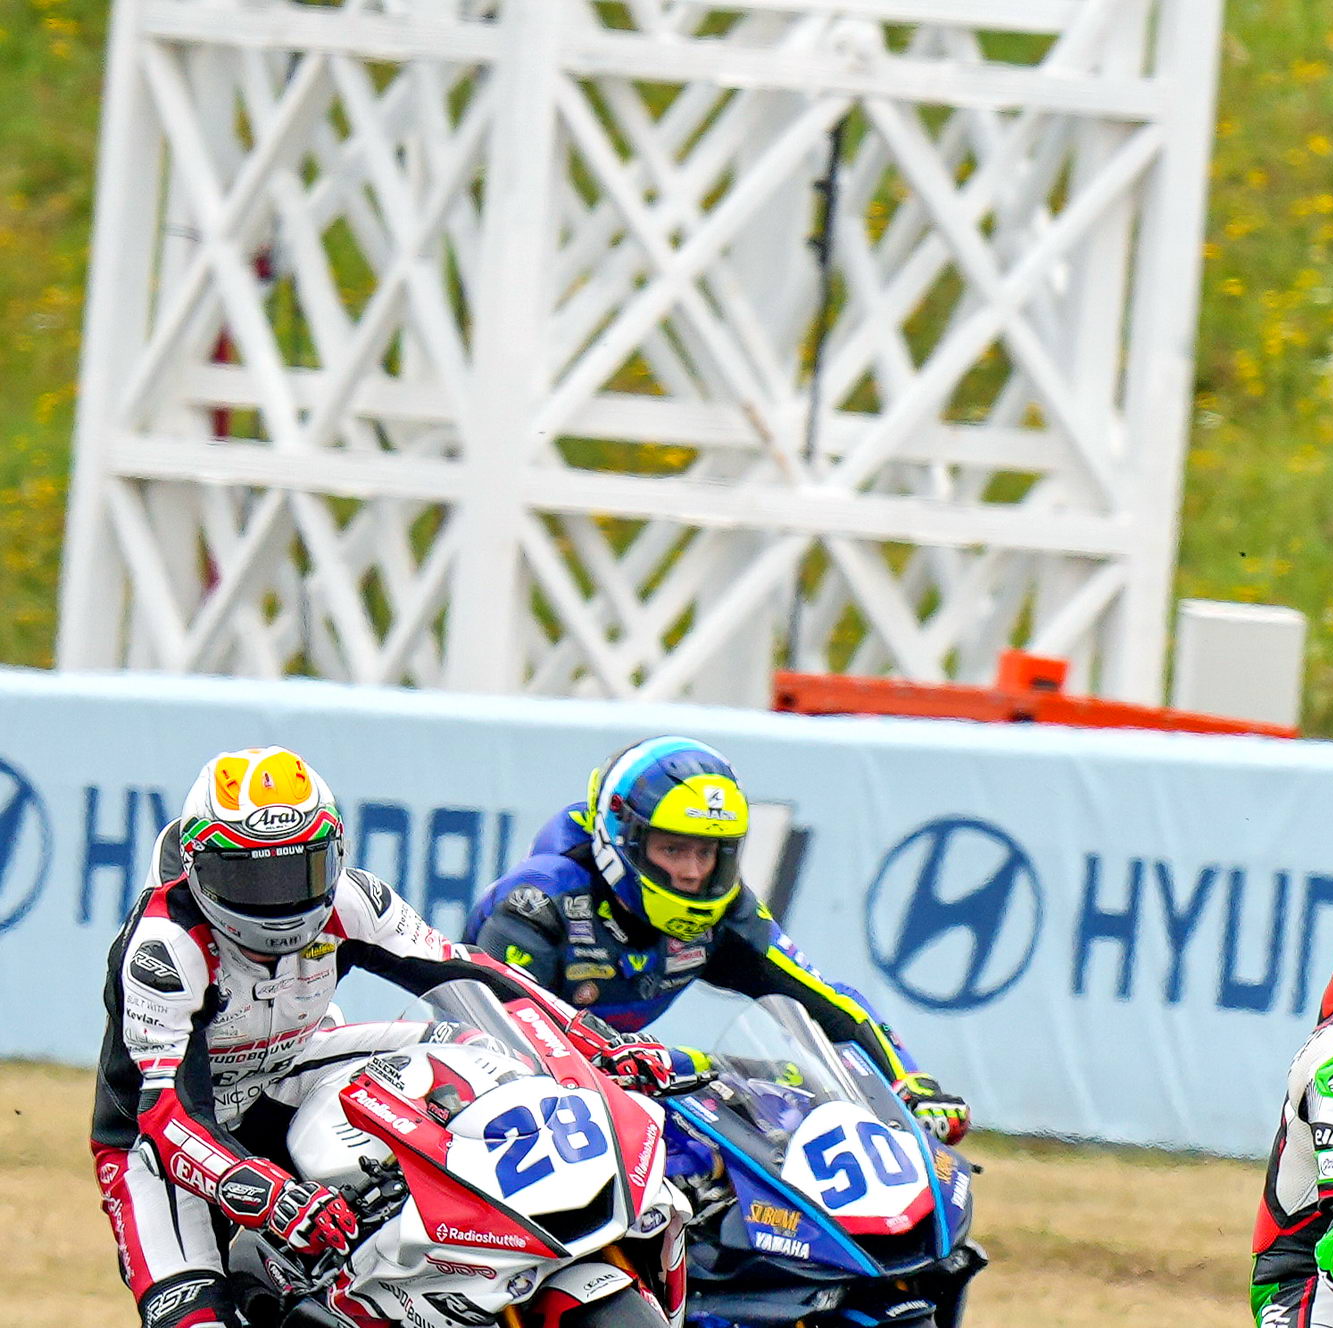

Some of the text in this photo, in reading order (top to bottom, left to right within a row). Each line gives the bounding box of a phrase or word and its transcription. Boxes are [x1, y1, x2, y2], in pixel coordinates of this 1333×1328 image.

[253, 807, 298, 826] Arai
[131, 950, 181, 980] RST
[372, 1056, 403, 1080] GLENN
[483, 1095, 608, 1200] 28
[802, 1120, 919, 1210] 50
[449, 1227, 527, 1248] Radioshuttle
[754, 1231, 811, 1260] YAMAHA
[146, 1278, 216, 1322] RST
